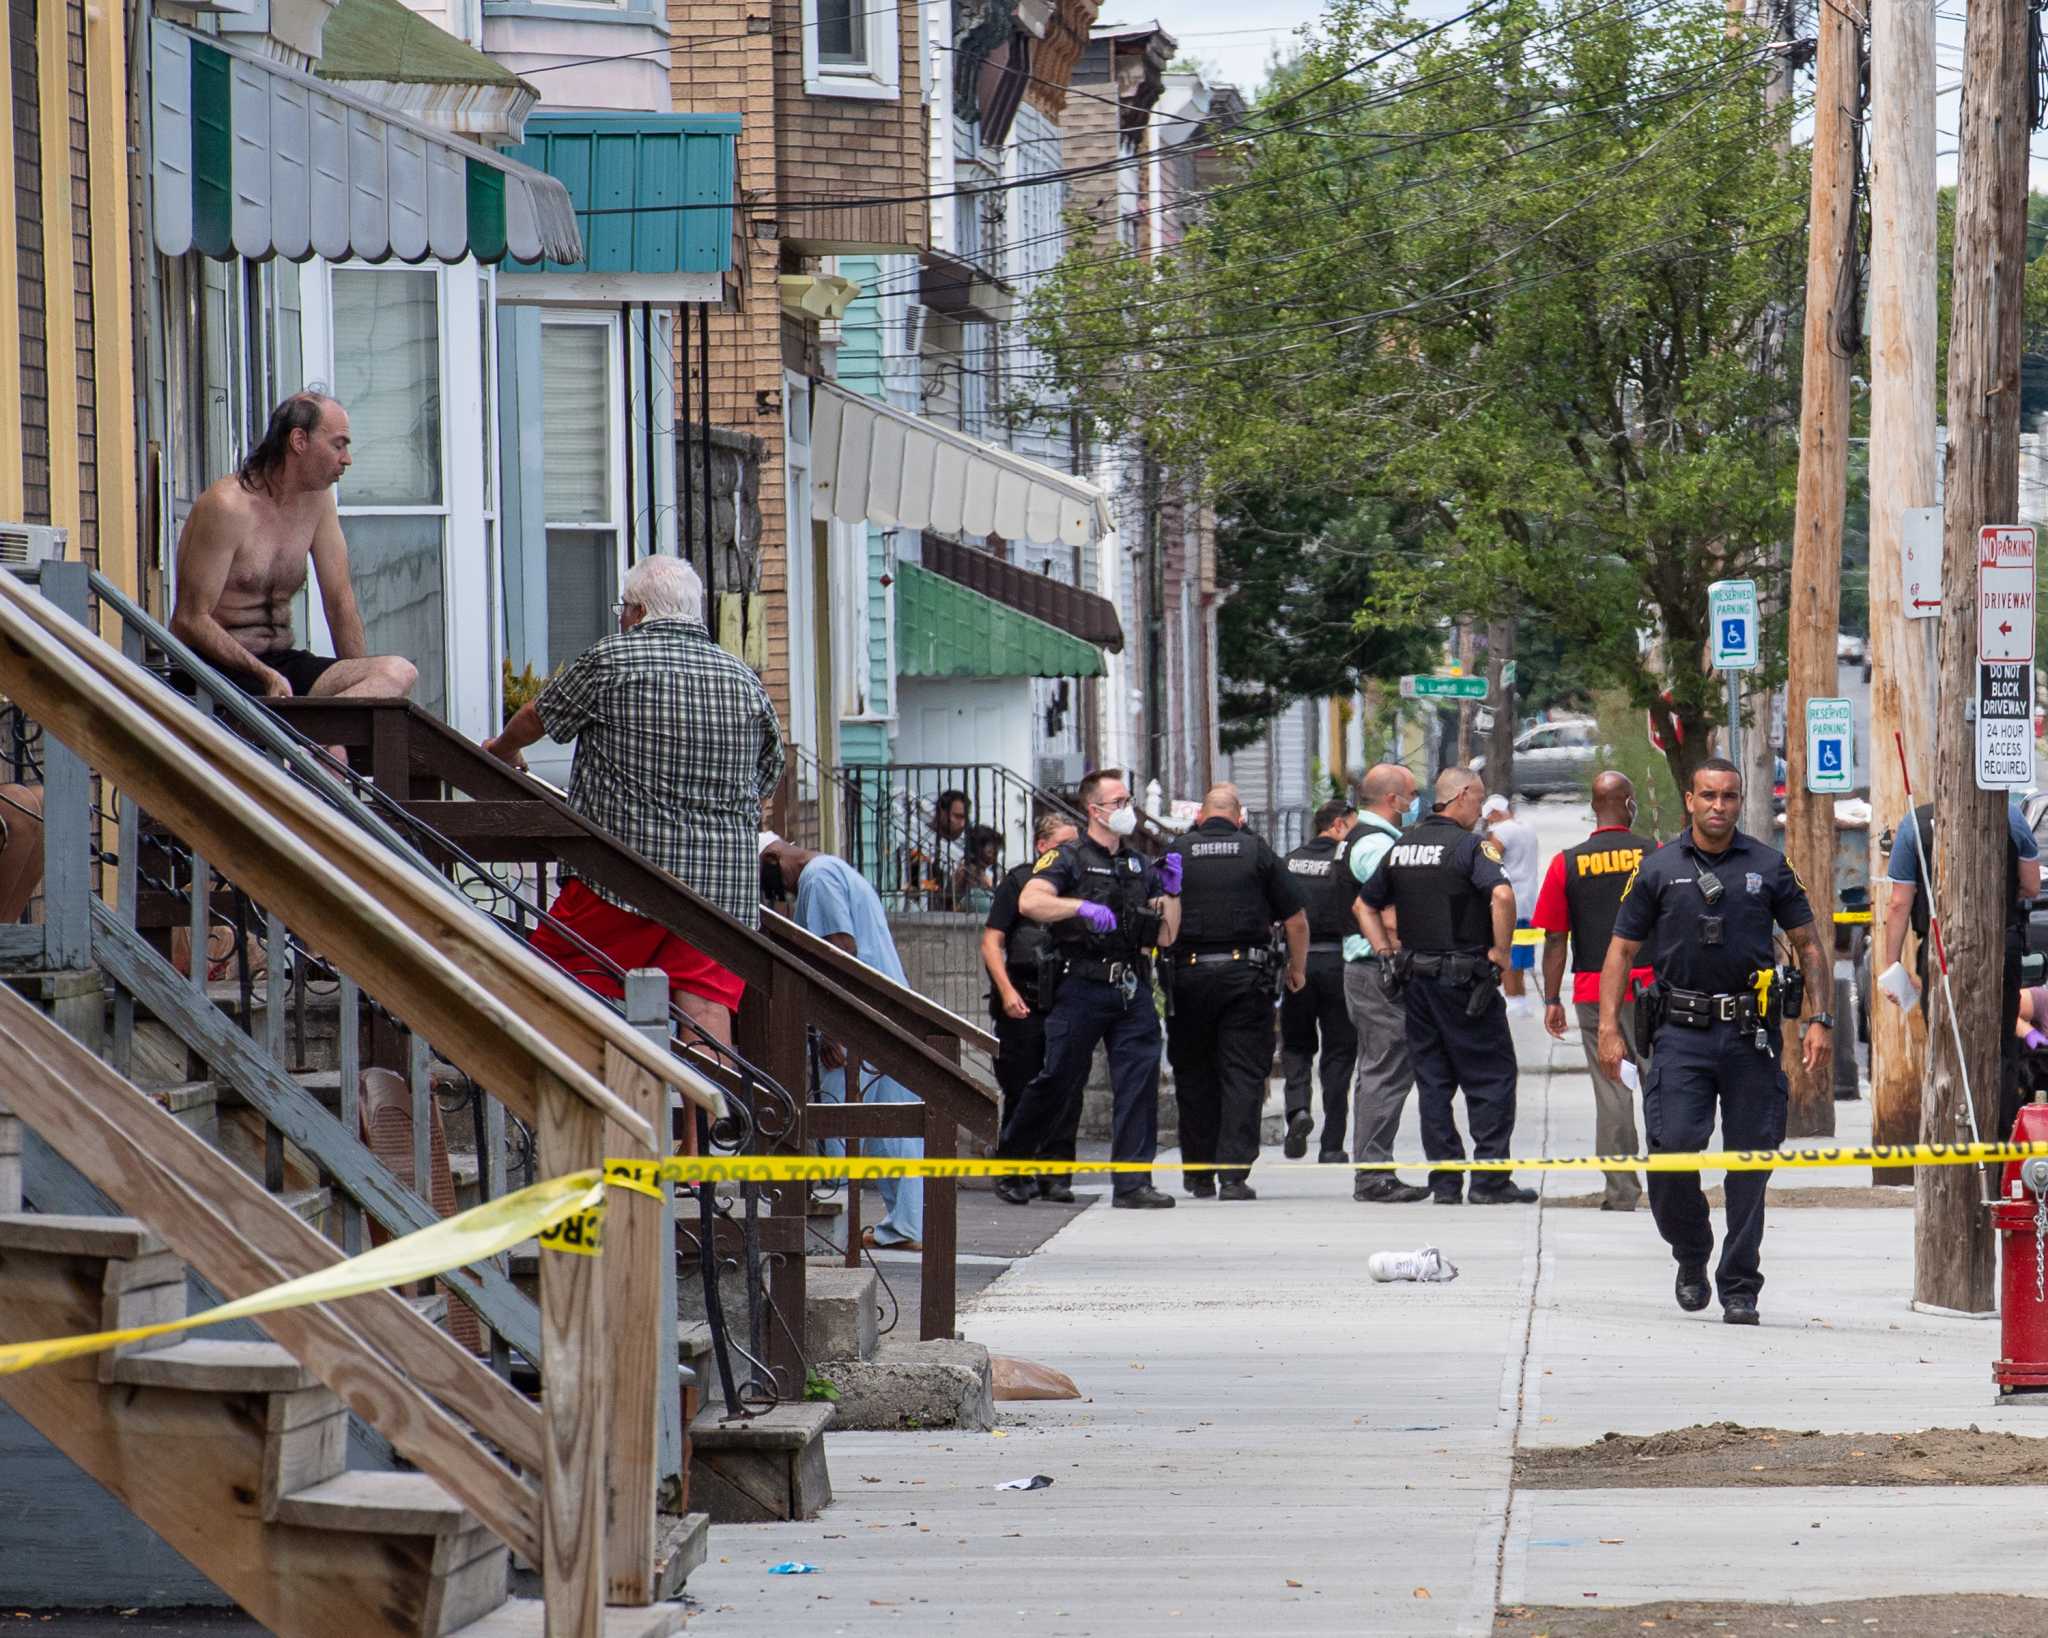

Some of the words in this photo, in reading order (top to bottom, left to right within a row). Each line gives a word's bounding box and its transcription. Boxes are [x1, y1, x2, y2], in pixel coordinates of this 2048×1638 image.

[1982, 536, 1997, 562] NO
[1998, 540, 2032, 557] PARKING
[1712, 589, 1752, 601] RESERVED
[1984, 592, 2032, 609] DRIVEWAY
[1716, 603, 1750, 615] PARKING
[1989, 665, 2003, 679] DO
[2004, 665, 2020, 679] NOT
[1991, 682, 2019, 697] BLOCK
[1808, 707, 1849, 719] RESERVED
[1983, 699, 2027, 715] DRIVEWAY
[1813, 723, 1846, 735] PARKING
[1986, 723, 1998, 738] 24
[2001, 724, 2024, 738] HOUR
[1988, 742, 2022, 756] ACCESS
[1984, 760, 2027, 776] REQUIRED
[1191, 841, 1240, 857] SHERIFF
[1388, 844, 1445, 867] POLICE
[1287, 858, 1331, 875] SHERIFF
[1576, 848, 1643, 876] POLICE
